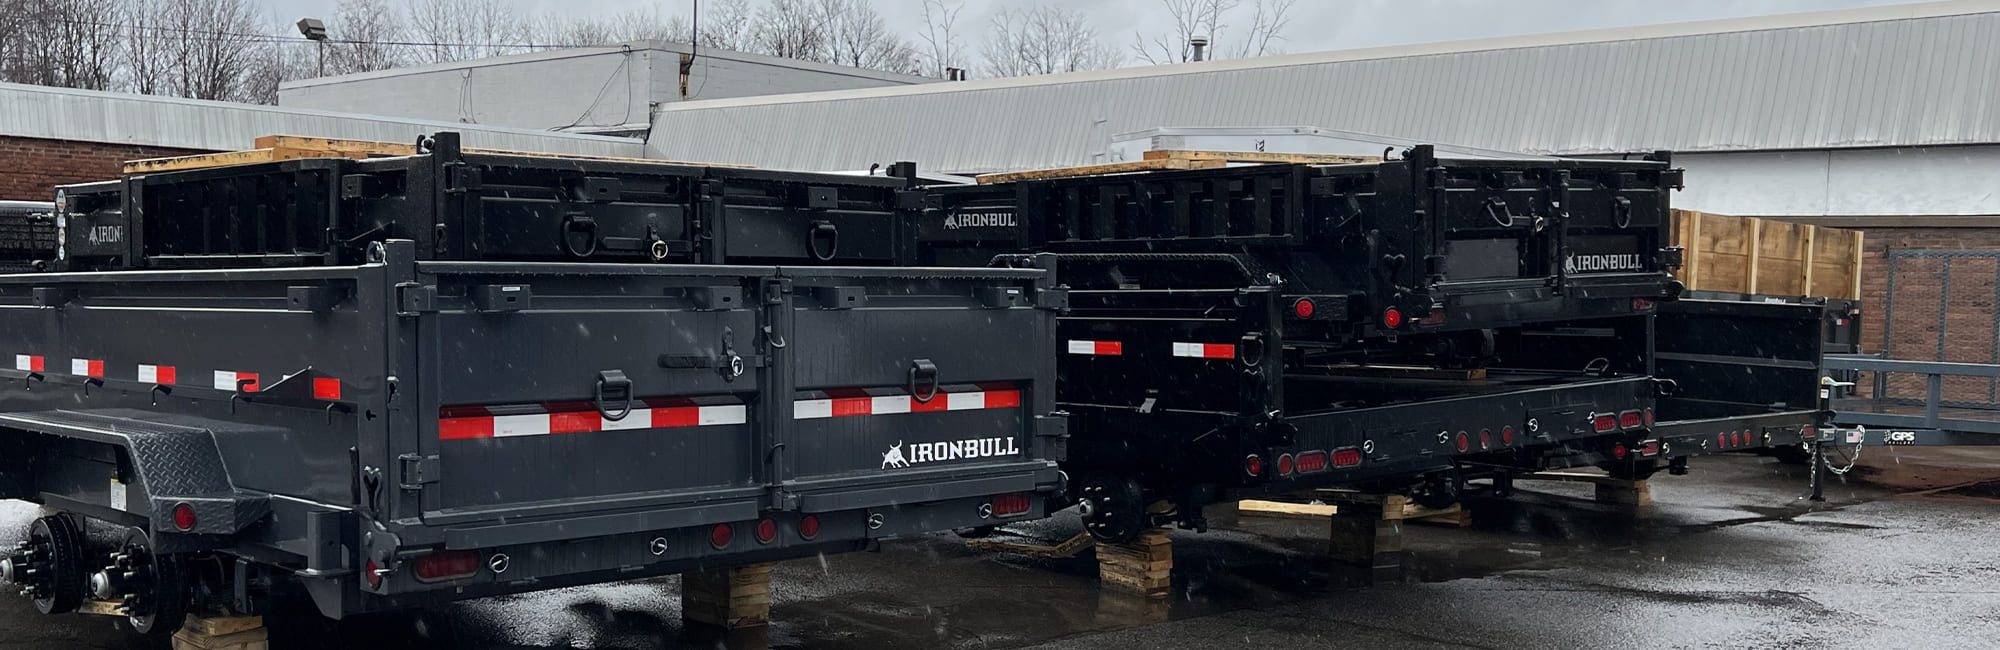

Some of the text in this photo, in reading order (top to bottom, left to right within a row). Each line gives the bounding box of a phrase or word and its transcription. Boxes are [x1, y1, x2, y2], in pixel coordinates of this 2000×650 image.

[958, 213, 1018, 227] IRONBUL
[98, 225, 123, 242] IRON
[1577, 253, 1643, 271] IRONBULL
[1891, 431, 1915, 441] GPS
[909, 436, 1019, 463] IRONBULL
